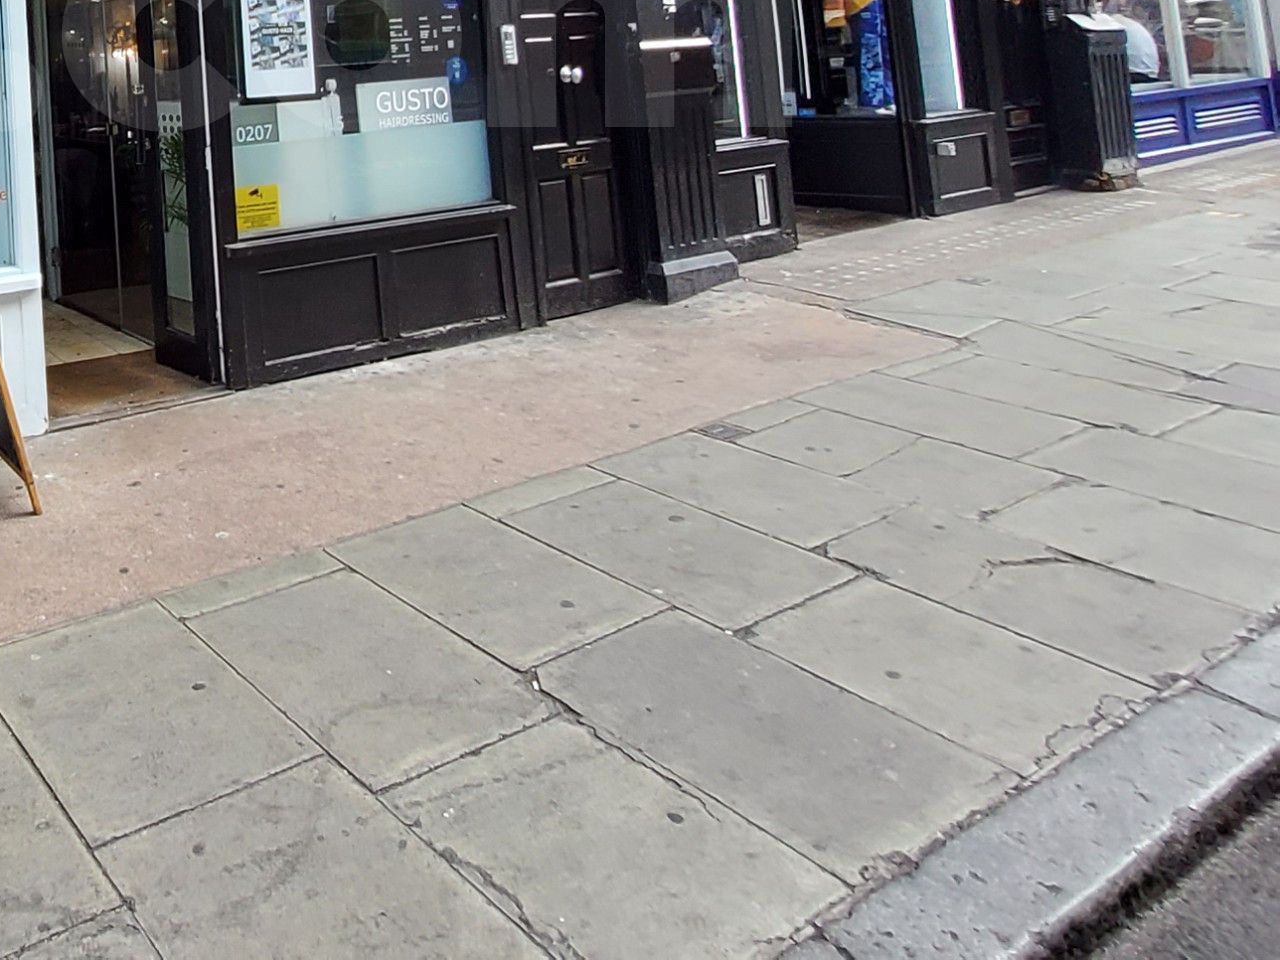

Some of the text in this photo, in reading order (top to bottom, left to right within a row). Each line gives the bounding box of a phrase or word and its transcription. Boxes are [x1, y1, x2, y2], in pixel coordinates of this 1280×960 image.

[375, 87, 449, 114] GUSTO
[378, 111, 450, 130] HAIRDRESSING
[236, 124, 273, 143] 0207
